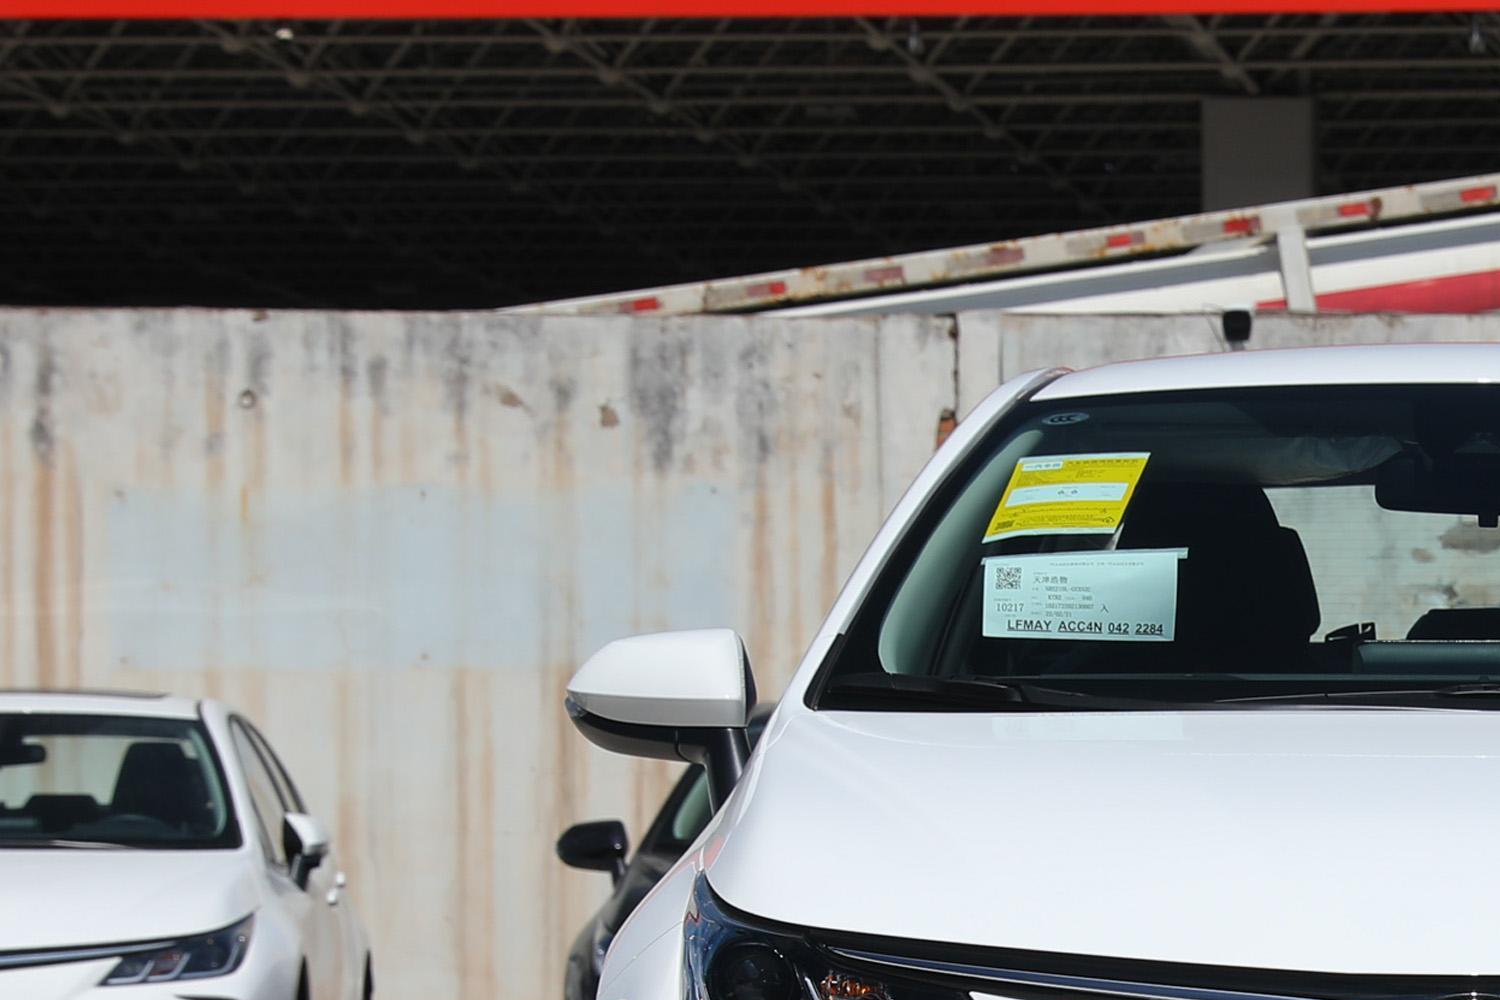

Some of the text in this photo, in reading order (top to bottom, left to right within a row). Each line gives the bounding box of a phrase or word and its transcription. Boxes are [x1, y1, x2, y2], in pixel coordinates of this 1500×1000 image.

[996, 603, 1024, 612] 10217
[1007, 619, 1163, 635] LFMAY ACC4N 042 2284
